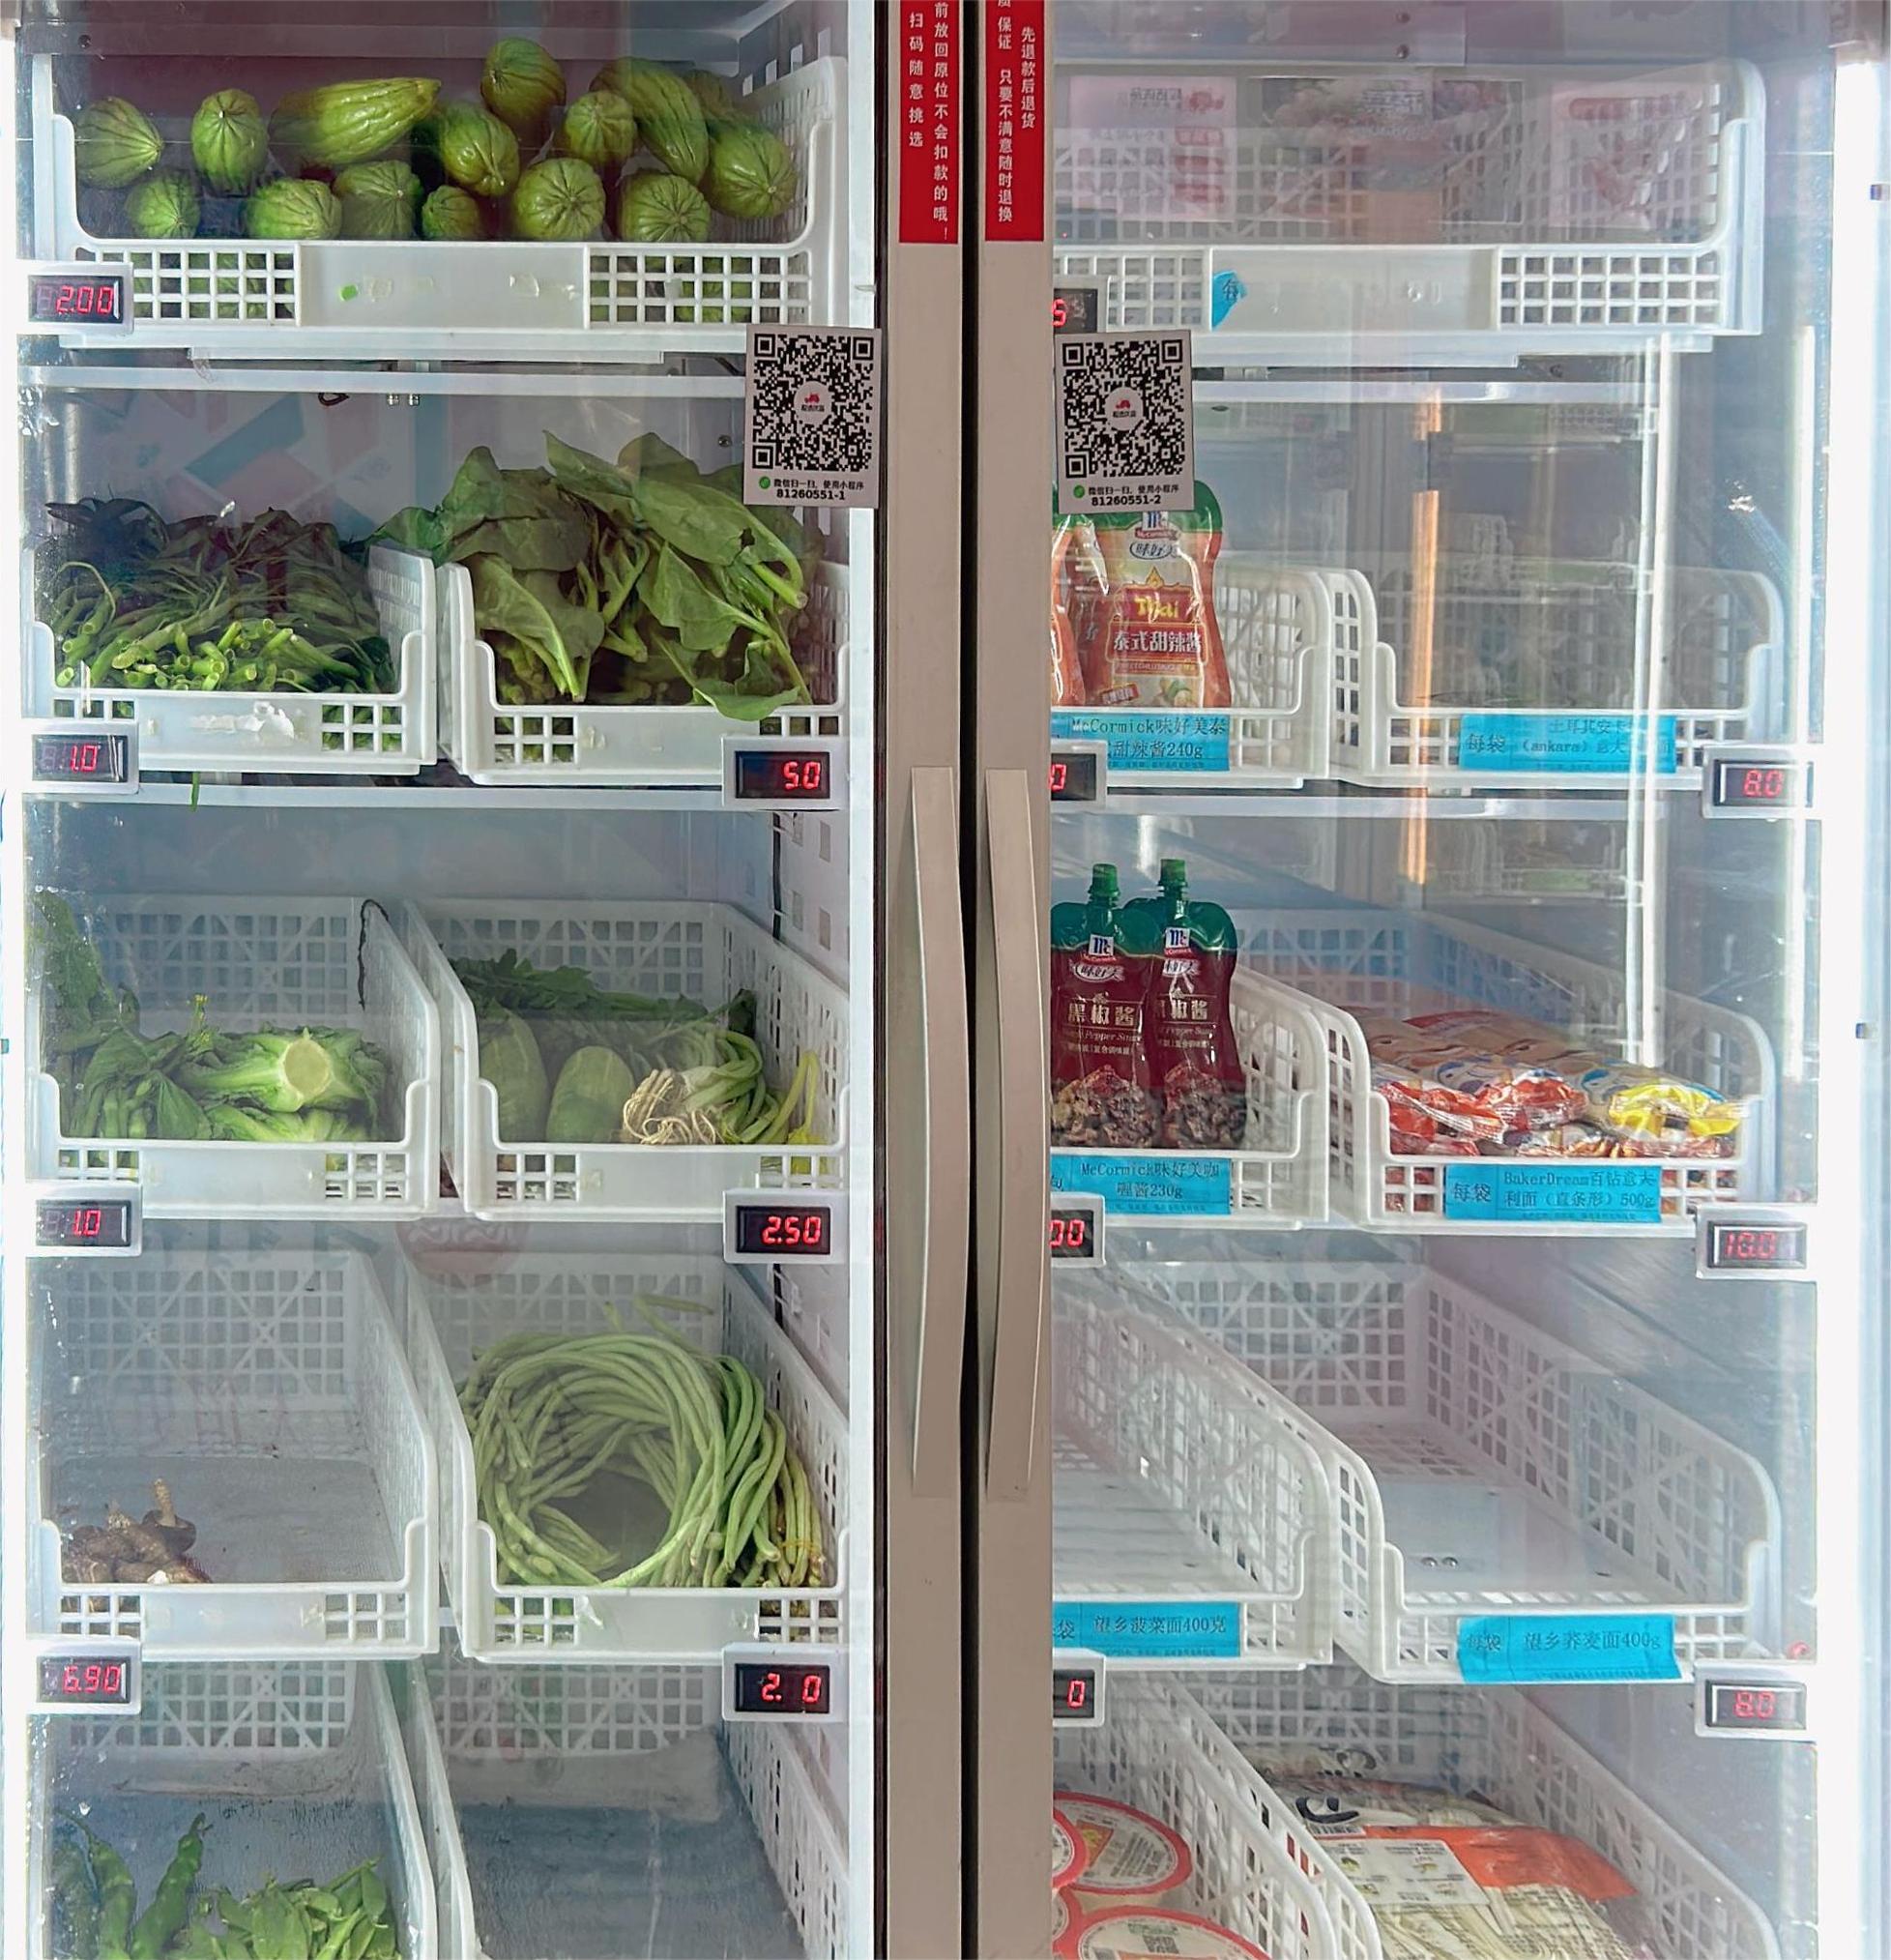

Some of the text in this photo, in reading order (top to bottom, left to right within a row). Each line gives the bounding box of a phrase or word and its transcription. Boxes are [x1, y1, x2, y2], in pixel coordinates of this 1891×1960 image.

[908, 12, 924, 148] 扫码随意挑选
[1020, 26, 1035, 129] 先退款后退货
[998, 69, 1013, 222] 只要不满意随时退换
[55, 284, 114, 315] 2.00
[776, 488, 846, 500] 81260551-1
[1091, 494, 1162, 507] 81260551-2
[1134, 595, 1179, 619] Thai
[1114, 630, 1202, 653] 泰式甜辣酱
[1107, 741, 1204, 759] 甜辣酱240g
[1453, 1182, 1492, 1203] 每袋
[761, 1215, 822, 1244] 2.50
[63, 1664, 122, 1694] 6.90
